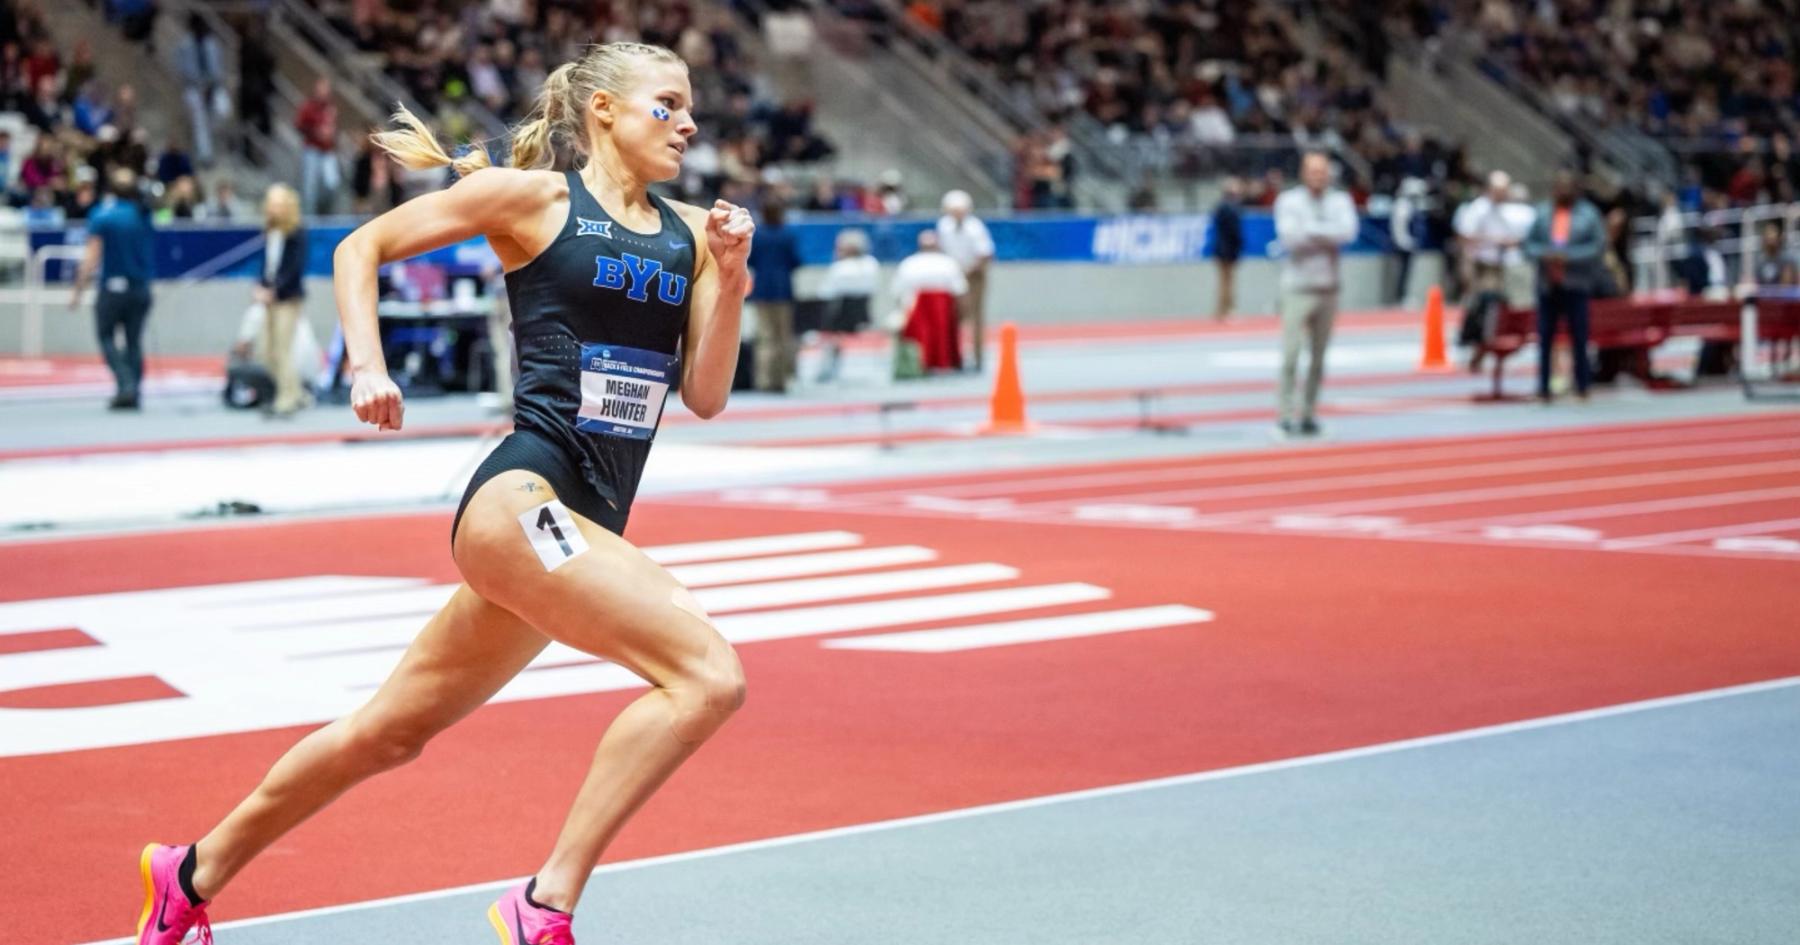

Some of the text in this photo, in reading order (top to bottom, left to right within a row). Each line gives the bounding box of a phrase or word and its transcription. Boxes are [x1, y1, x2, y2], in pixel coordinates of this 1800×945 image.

[593, 252, 687, 305] BYU
[605, 379, 651, 400] MEGHAN
[600, 398, 647, 422] HUNTER
[536, 505, 574, 557] 1
